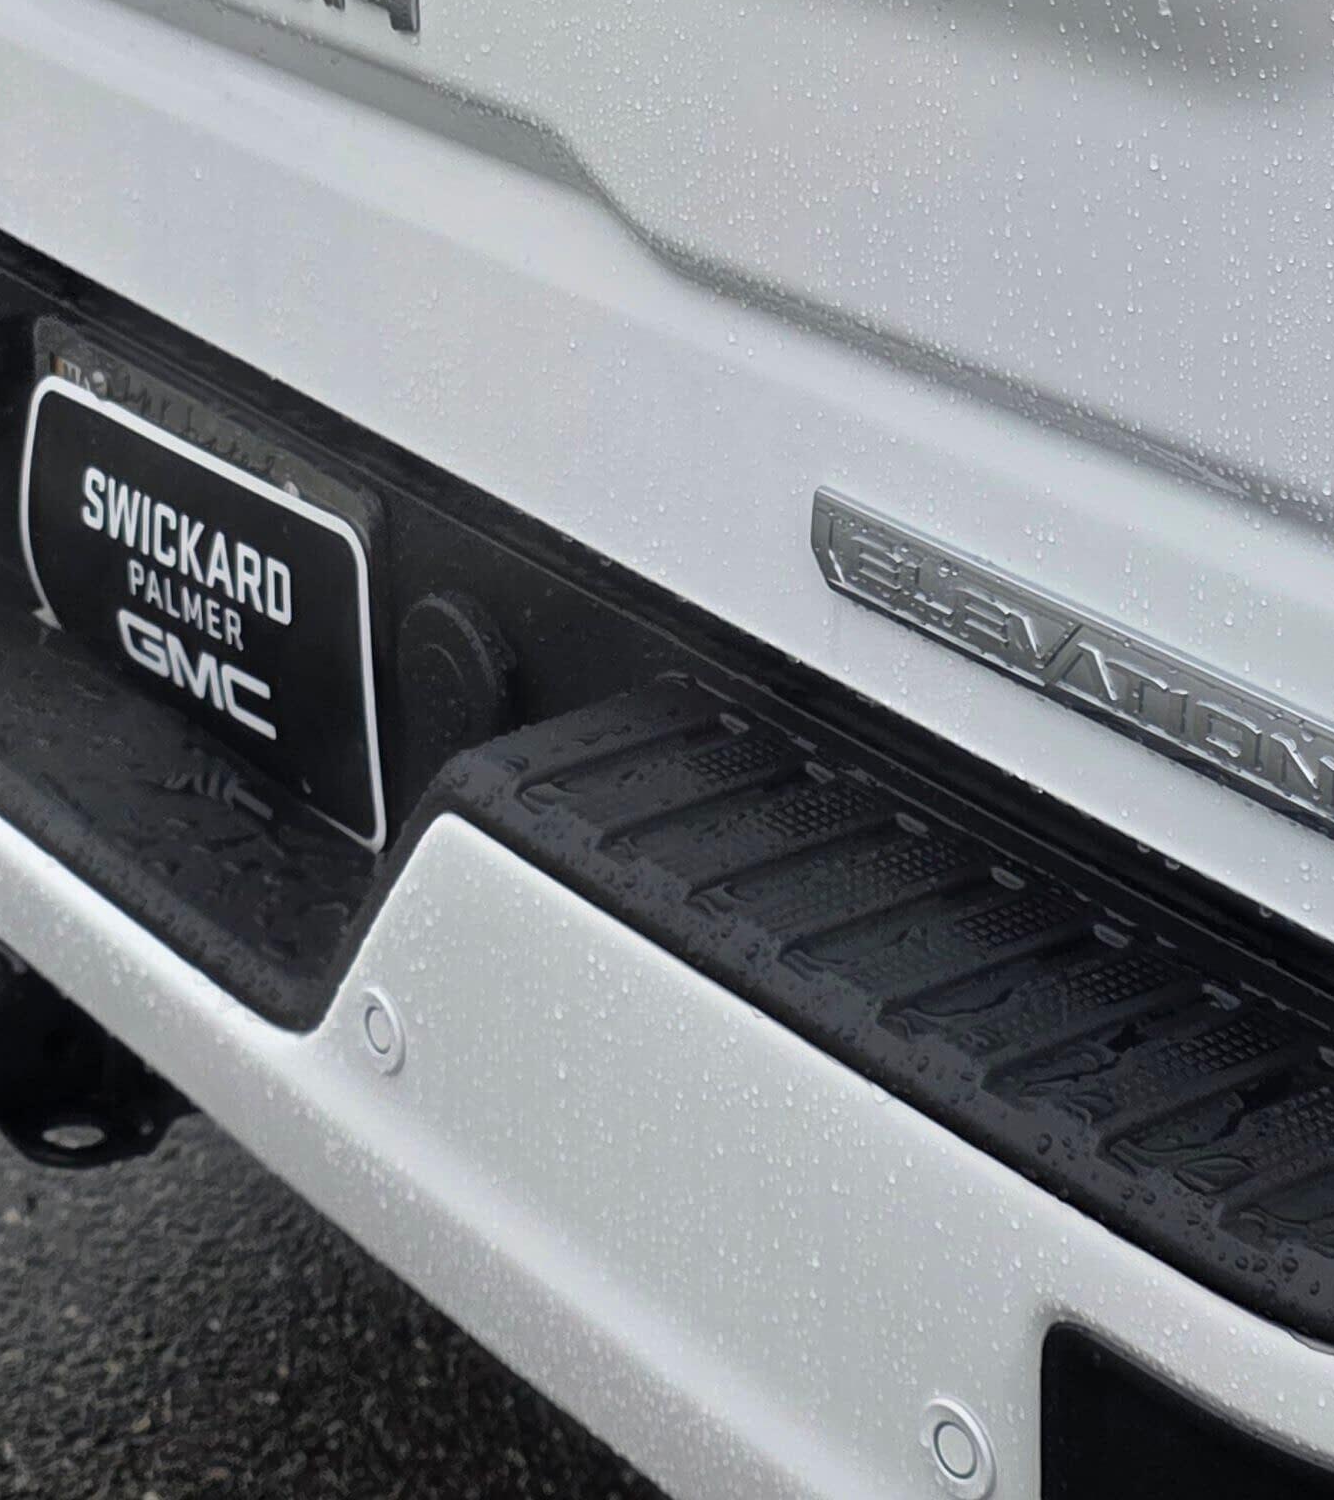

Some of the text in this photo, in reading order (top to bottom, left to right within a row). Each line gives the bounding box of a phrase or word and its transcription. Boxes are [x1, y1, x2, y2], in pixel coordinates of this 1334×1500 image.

[81, 466, 292, 626] SWICKARD
[128, 559, 244, 651] PALMER
[117, 608, 277, 740] GMC
